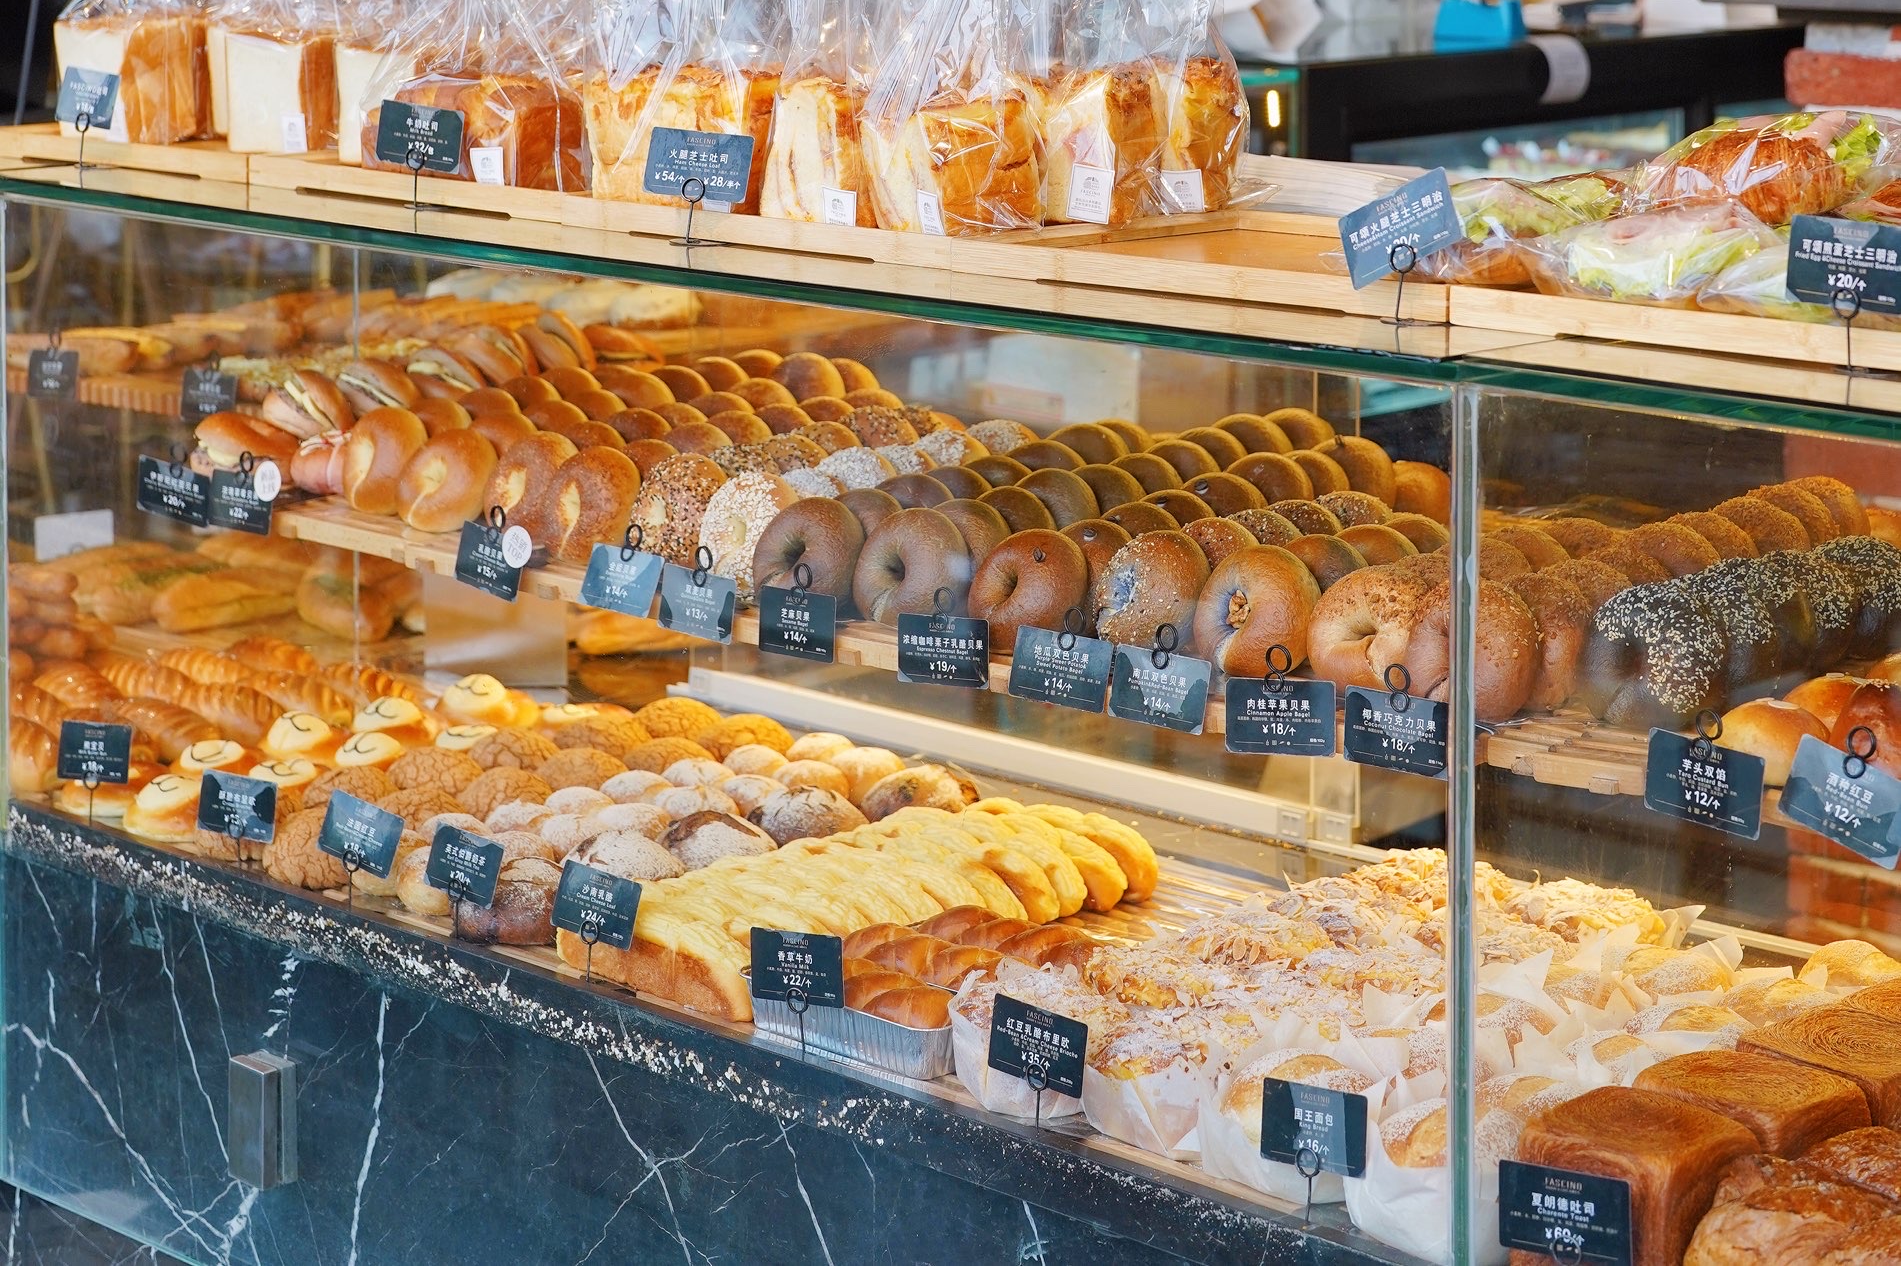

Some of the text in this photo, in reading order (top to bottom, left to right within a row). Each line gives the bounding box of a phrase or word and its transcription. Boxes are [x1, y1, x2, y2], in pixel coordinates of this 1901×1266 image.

[406, 117, 439, 132] 牛奶吐司
[687, 136, 716, 145] FASCINO
[669, 148, 729, 164] 火腿芝士吐司
[688, 160, 708, 168] Cheese
[655, 171, 685, 184] ¥54/个
[1349, 190, 1443, 245] 可颂火腿芝士三明治
[1828, 273, 1867, 292] ¥20/个
[507, 542, 523, 560] TOP
[685, 607, 708, 622] ¥13/个
[781, 608, 810, 622] 芝麻贝果
[784, 631, 808, 644] ¥14/个
[903, 634, 984, 651] 浓缩咖啡栗子乳酪贝果
[1034, 644, 1089, 664] 地瓜双色贝果
[929, 661, 957, 674] ¥19/个
[1052, 664, 1068, 672] Potato
[1069, 667, 1084, 675] Bagel
[1044, 677, 1073, 693] ¥14/个
[1132, 668, 1187, 688] 南瓜双色贝果
[1175, 687, 1189, 695] Bagel
[1143, 697, 1171, 712] ¥14/个
[1246, 698, 1310, 711] 肉桂苹果贝果
[1362, 708, 1436, 732] 椰香巧克力贝果
[1262, 723, 1297, 736] ¥18/个
[1363, 720, 1387, 730] Coconut
[1388, 724, 1417, 735] Chocolate
[1417, 731, 1434, 739] Bagel
[1382, 738, 1416, 754] ¥18/个
[1682, 758, 1727, 782] 芋头双馅
[1678, 769, 1692, 779] Taro
[1692, 773, 1716, 786] Custard
[1717, 781, 1729, 789] Bun
[1826, 771, 1875, 805] 酒种红豆
[1684, 789, 1721, 810] ¥12/个
[1855, 800, 1869, 811] Bun
[1824, 801, 1862, 829] ¥12/个
[606, 902, 617, 910] Loaf
[782, 937, 809, 946] FASCINO
[777, 950, 813, 965] 香草牛奶
[783, 974, 812, 988] ¥22/个
[1026, 1010, 1054, 1024] FASCINO
[1006, 1016, 1070, 1050] 红豆乳酪布里欧
[1039, 1040, 1059, 1052] Cheese
[1059, 1046, 1079, 1059] Brioche
[1021, 1050, 1051, 1071] ¥35/个
[1300, 1091, 1331, 1104] FASCINO
[1294, 1107, 1334, 1127] 国王面包
[1299, 1121, 1329, 1132] King Bread
[1298, 1138, 1330, 1156] ¥16/个
[1544, 1176, 1583, 1191] FASCINO
[1531, 1191, 1596, 1217] 夏朗德吐司
[1536, 1206, 1569, 1219] Charente
[1570, 1213, 1590, 1223] Toast
